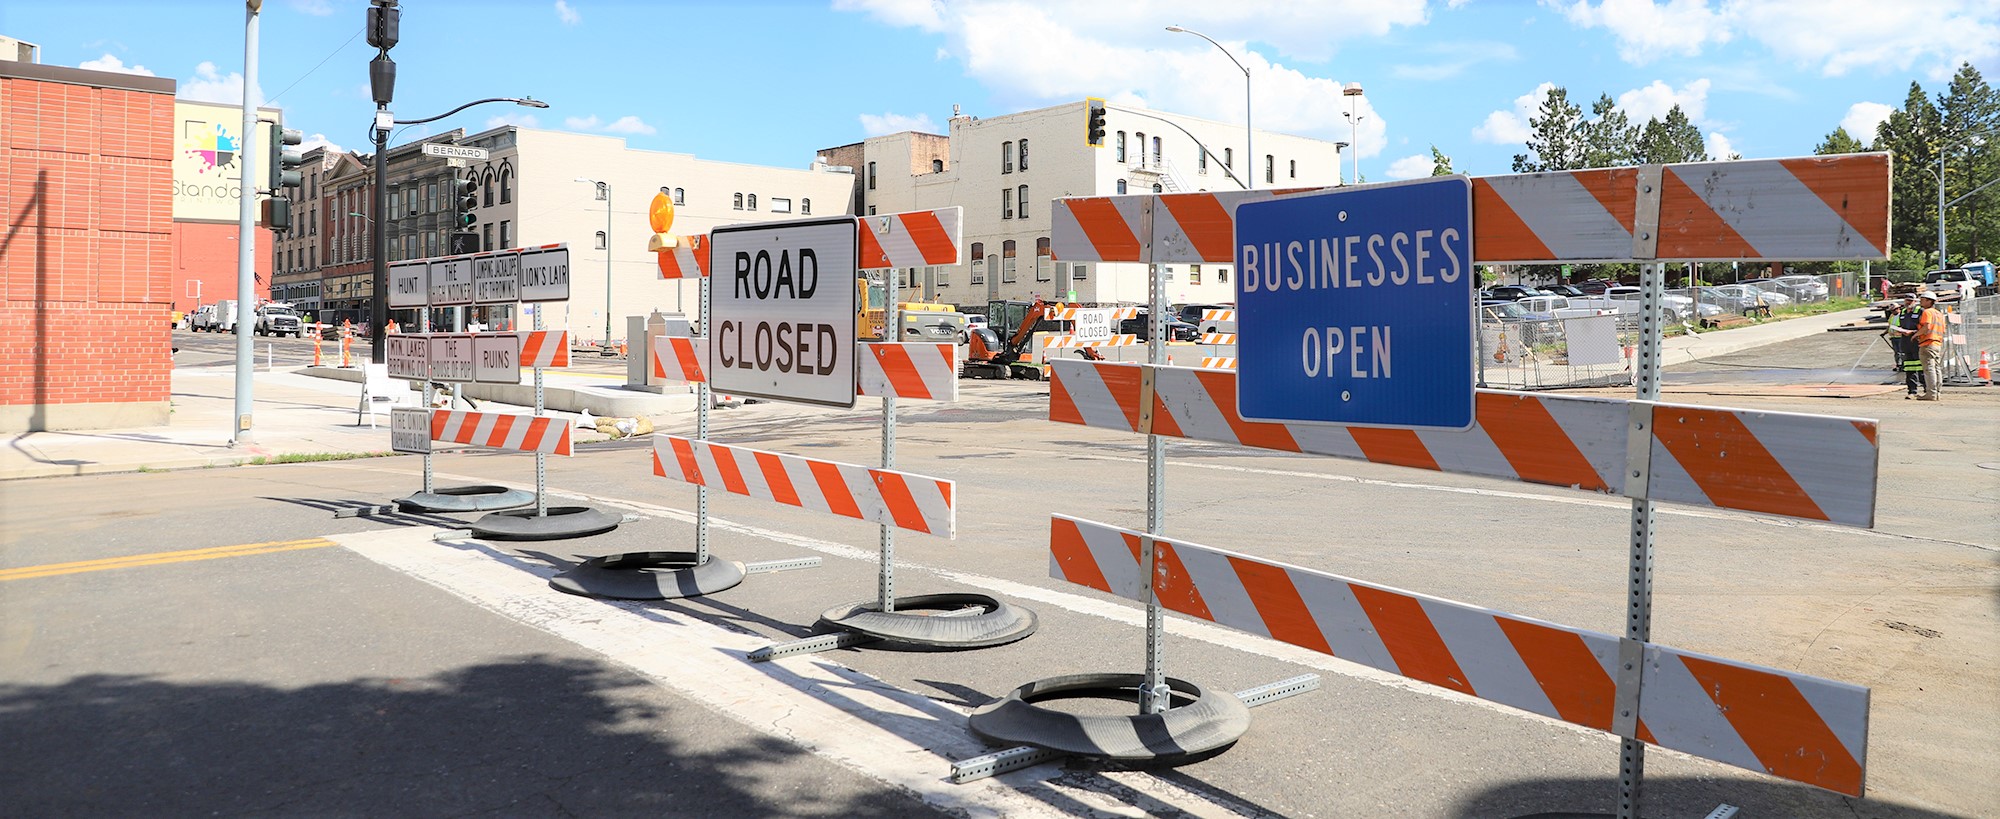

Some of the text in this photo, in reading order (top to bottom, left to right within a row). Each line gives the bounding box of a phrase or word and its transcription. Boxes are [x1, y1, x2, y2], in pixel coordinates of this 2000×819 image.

[433, 146, 481, 157] BERNARD
[173, 180, 262, 200] Standad
[476, 260, 493, 279] JUMPING
[1242, 228, 1461, 293] BUSINESSES
[445, 264, 457, 281] THE
[522, 265, 567, 287] LION'S LAIR
[734, 248, 818, 300] ROAD
[398, 277, 418, 294] HUNT
[432, 283, 471, 302] HIGH NOONER
[479, 280, 515, 299] AXE THROWING
[1083, 313, 1104, 324] ROAD
[1079, 326, 1108, 338] CLOSED
[407, 340, 425, 358] LAKES
[445, 340, 457, 357] THE
[719, 320, 837, 376] CLOSED
[1302, 326, 1392, 379] OPEN
[390, 358, 415, 376] BREWING
[483, 350, 510, 369] RUINS
[433, 360, 471, 378] HOUSE OF POP
[394, 413, 428, 431] THE ONION
